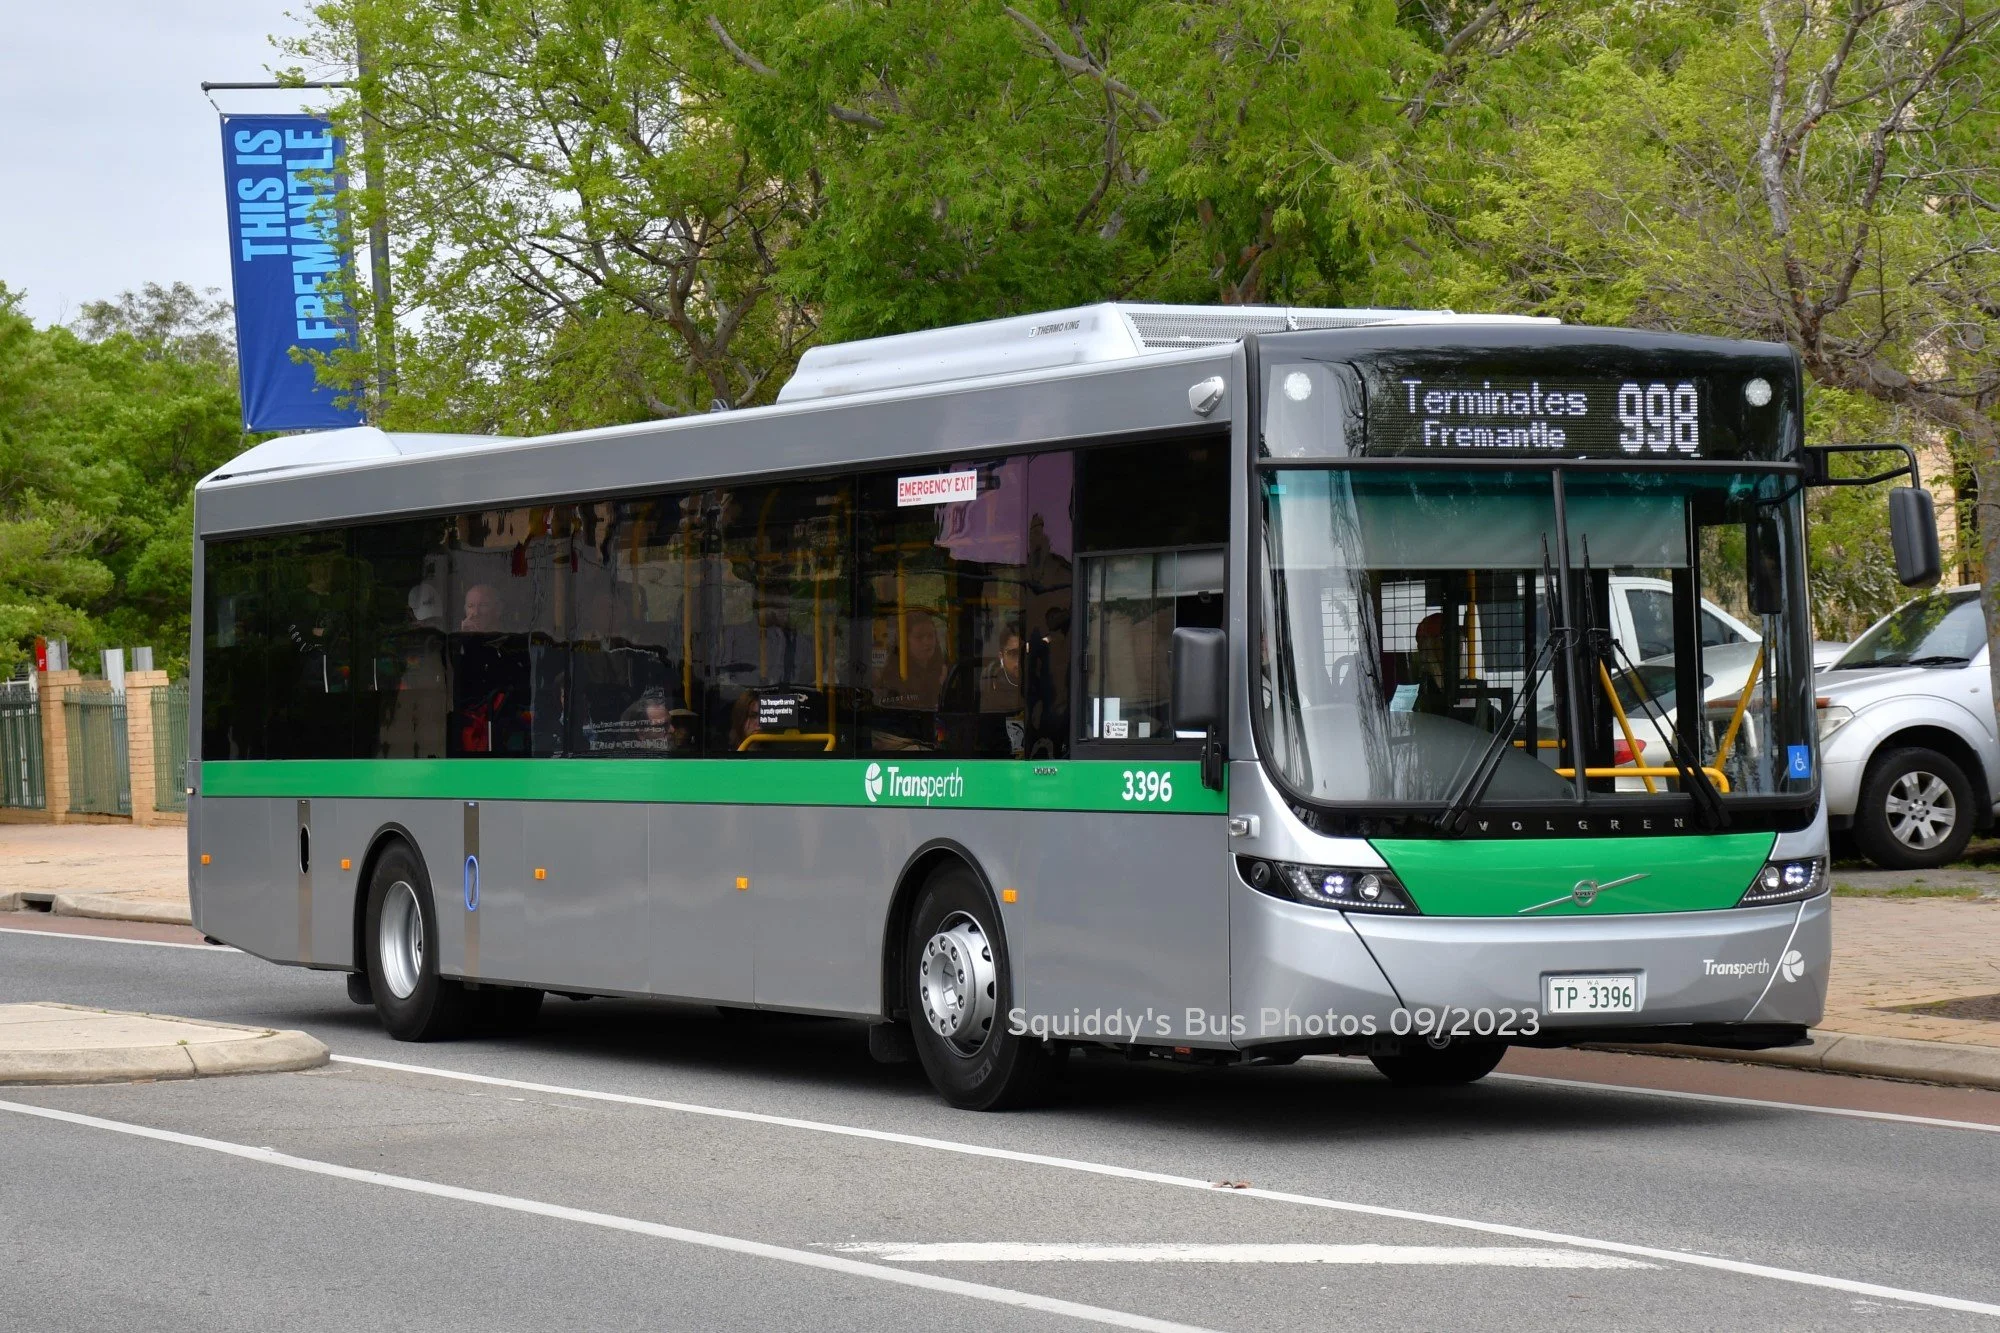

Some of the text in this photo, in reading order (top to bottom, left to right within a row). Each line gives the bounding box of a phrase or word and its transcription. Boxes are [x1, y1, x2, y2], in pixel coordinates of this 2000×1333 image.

[235, 129, 288, 261] THIS IS
[285, 129, 346, 339] FREMANTLE
[1036, 320, 1080, 335] THERMO KING
[1402, 379, 1588, 415] Terminates
[1618, 379, 1698, 452] 998
[1424, 420, 1566, 448] Fremantle
[899, 476, 975, 497] EMERGENCY EXIT
[887, 766, 964, 806] Transperth
[1121, 770, 1172, 802] 3396
[1479, 818, 1684, 831] VOLGREN
[1703, 958, 1770, 979] Transperth
